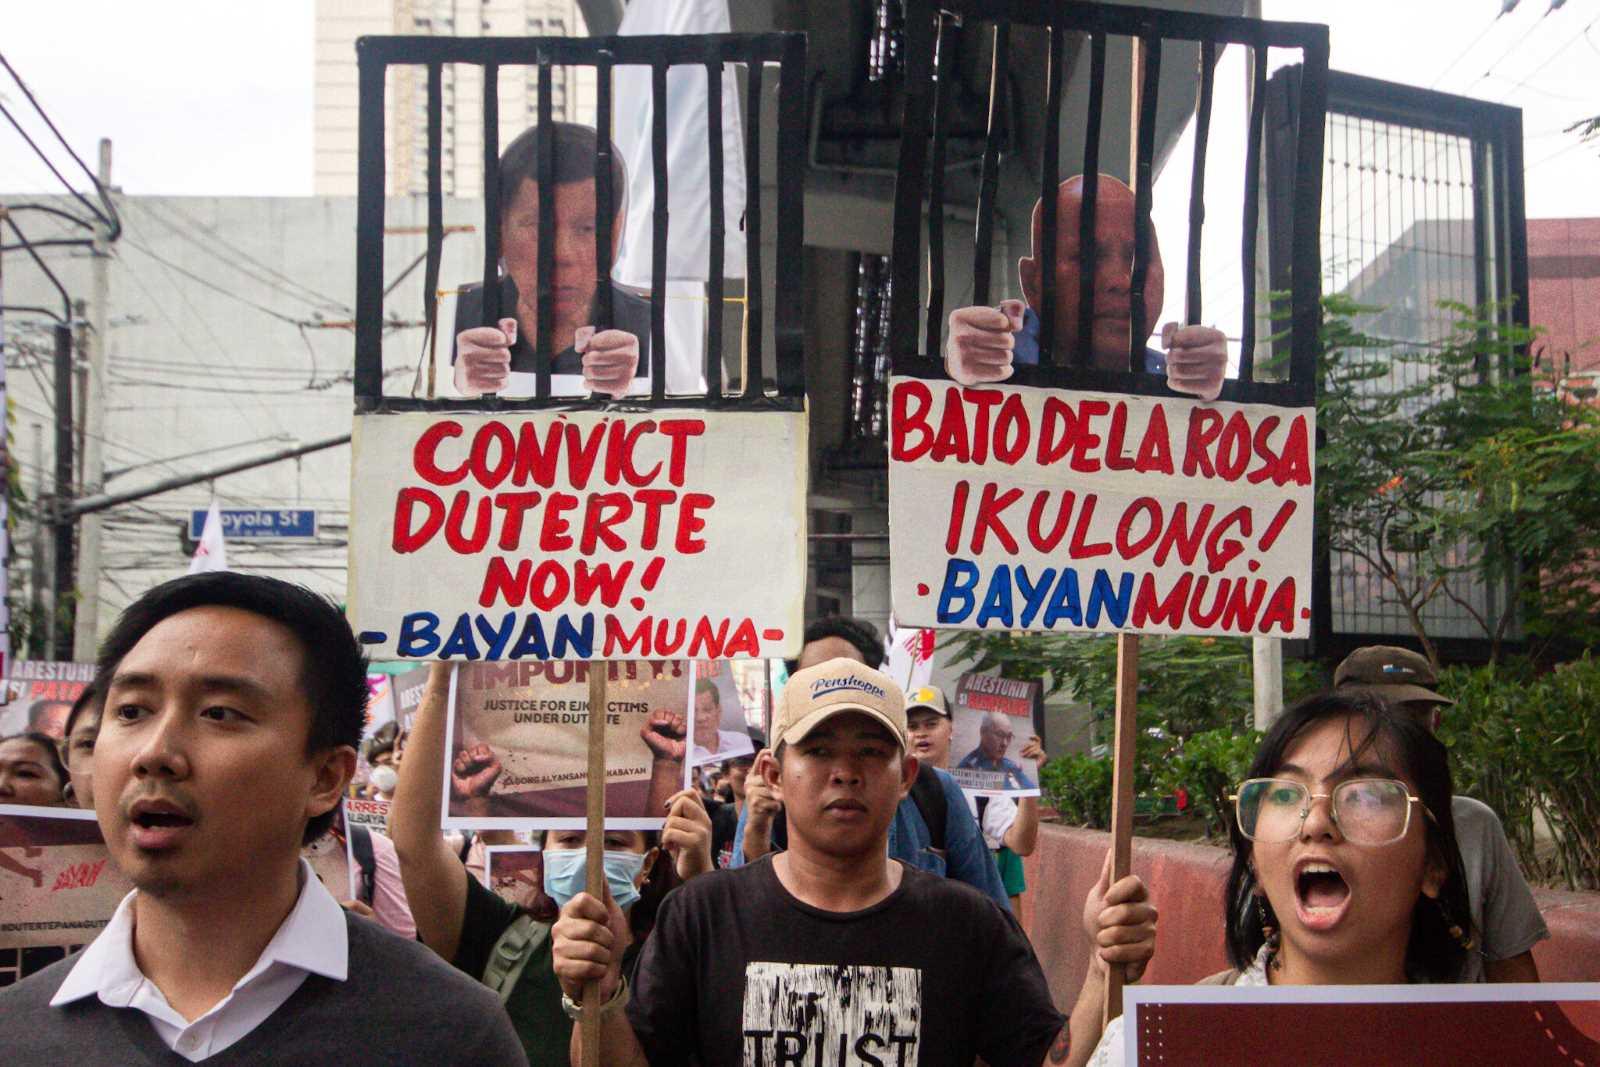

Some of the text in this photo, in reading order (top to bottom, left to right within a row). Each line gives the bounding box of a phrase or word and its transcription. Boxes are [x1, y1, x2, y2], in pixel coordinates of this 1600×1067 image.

[891, 381, 1031, 466] BATO
[1182, 406, 1312, 487] ROSA
[413, 418, 706, 491] CONVICT
[220, 510, 299, 528] oyola St
[391, 487, 716, 556] DUTERTE
[478, 556, 666, 612] NOW!
[810, 674, 887, 698] Penshoppe
[483, 699, 537, 711] JUSTICE
[540, 701, 566, 711] FOR
[607, 702, 648, 713] CTIMS
[514, 711, 620, 725] UNDER DUTTE
[744, 1030, 917, 1067] TRUST
